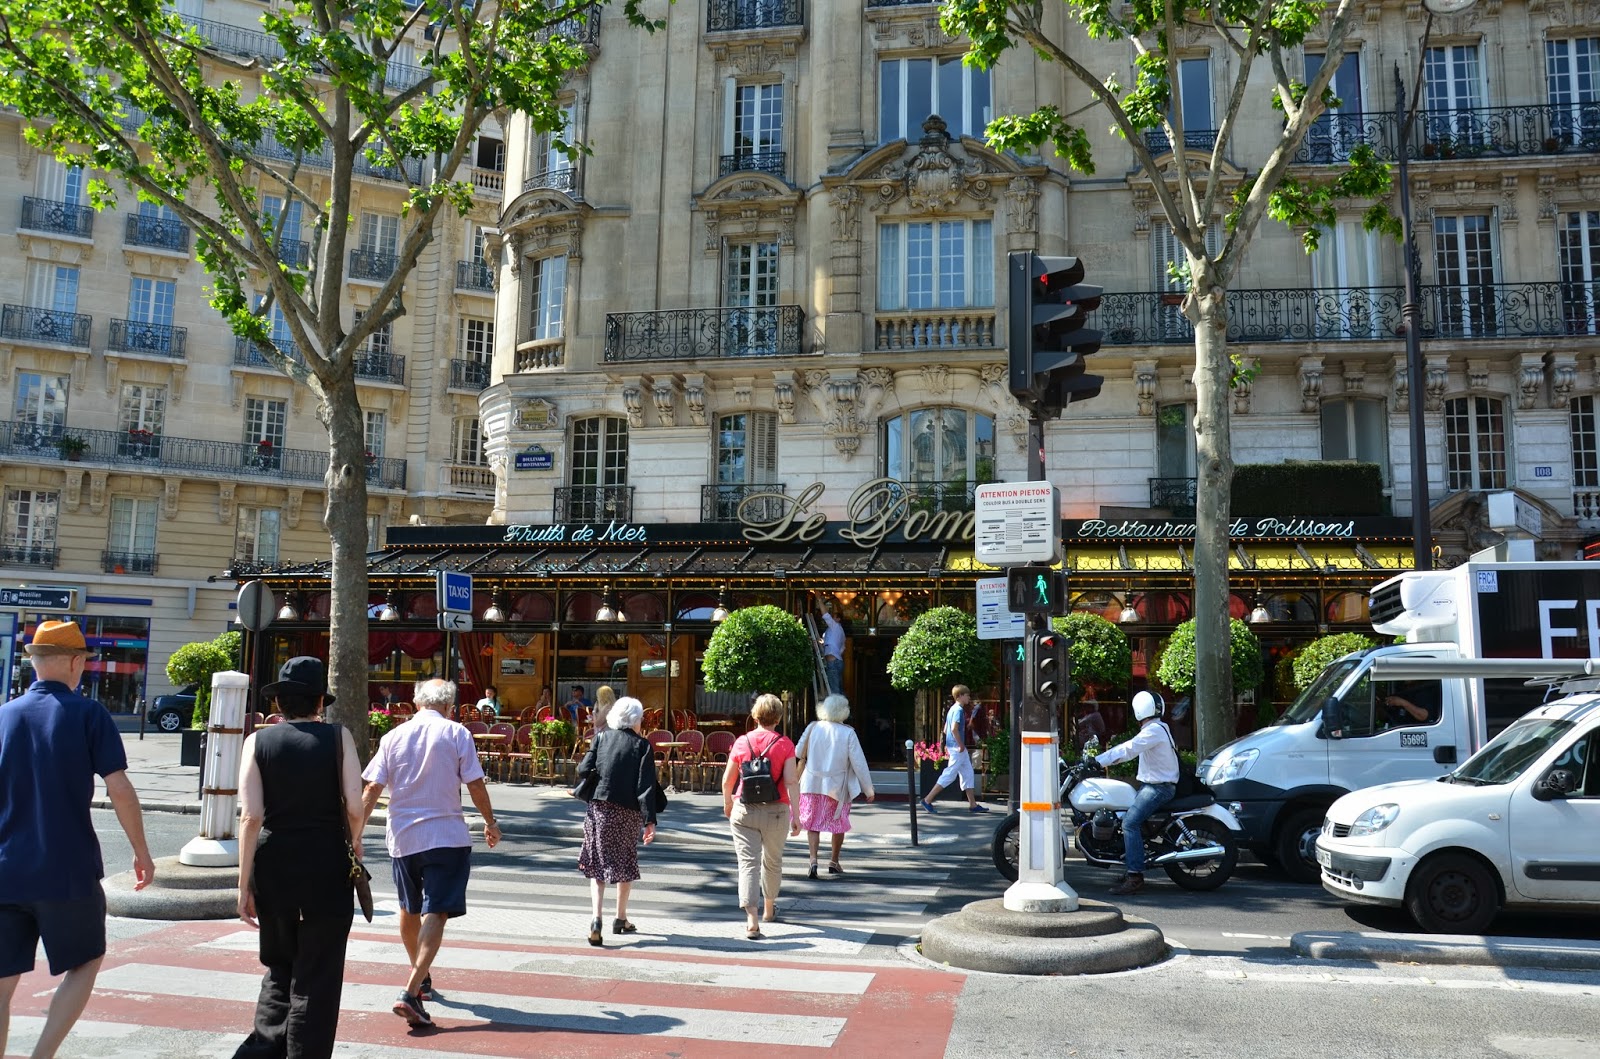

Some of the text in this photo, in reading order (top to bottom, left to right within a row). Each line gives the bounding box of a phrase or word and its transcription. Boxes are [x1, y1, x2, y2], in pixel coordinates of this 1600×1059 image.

[1536, 467, 1552, 477] 108
[981, 490, 1018, 498] ATTENTION
[737, 477, 976, 548] Le Dom
[503, 520, 647, 541] Fruits de Mer
[1255, 517, 1355, 537] Poissons
[1479, 573, 1496, 584] FRCX
[448, 585, 469, 599] TAXIS
[1402, 734, 1425, 745] 55692
